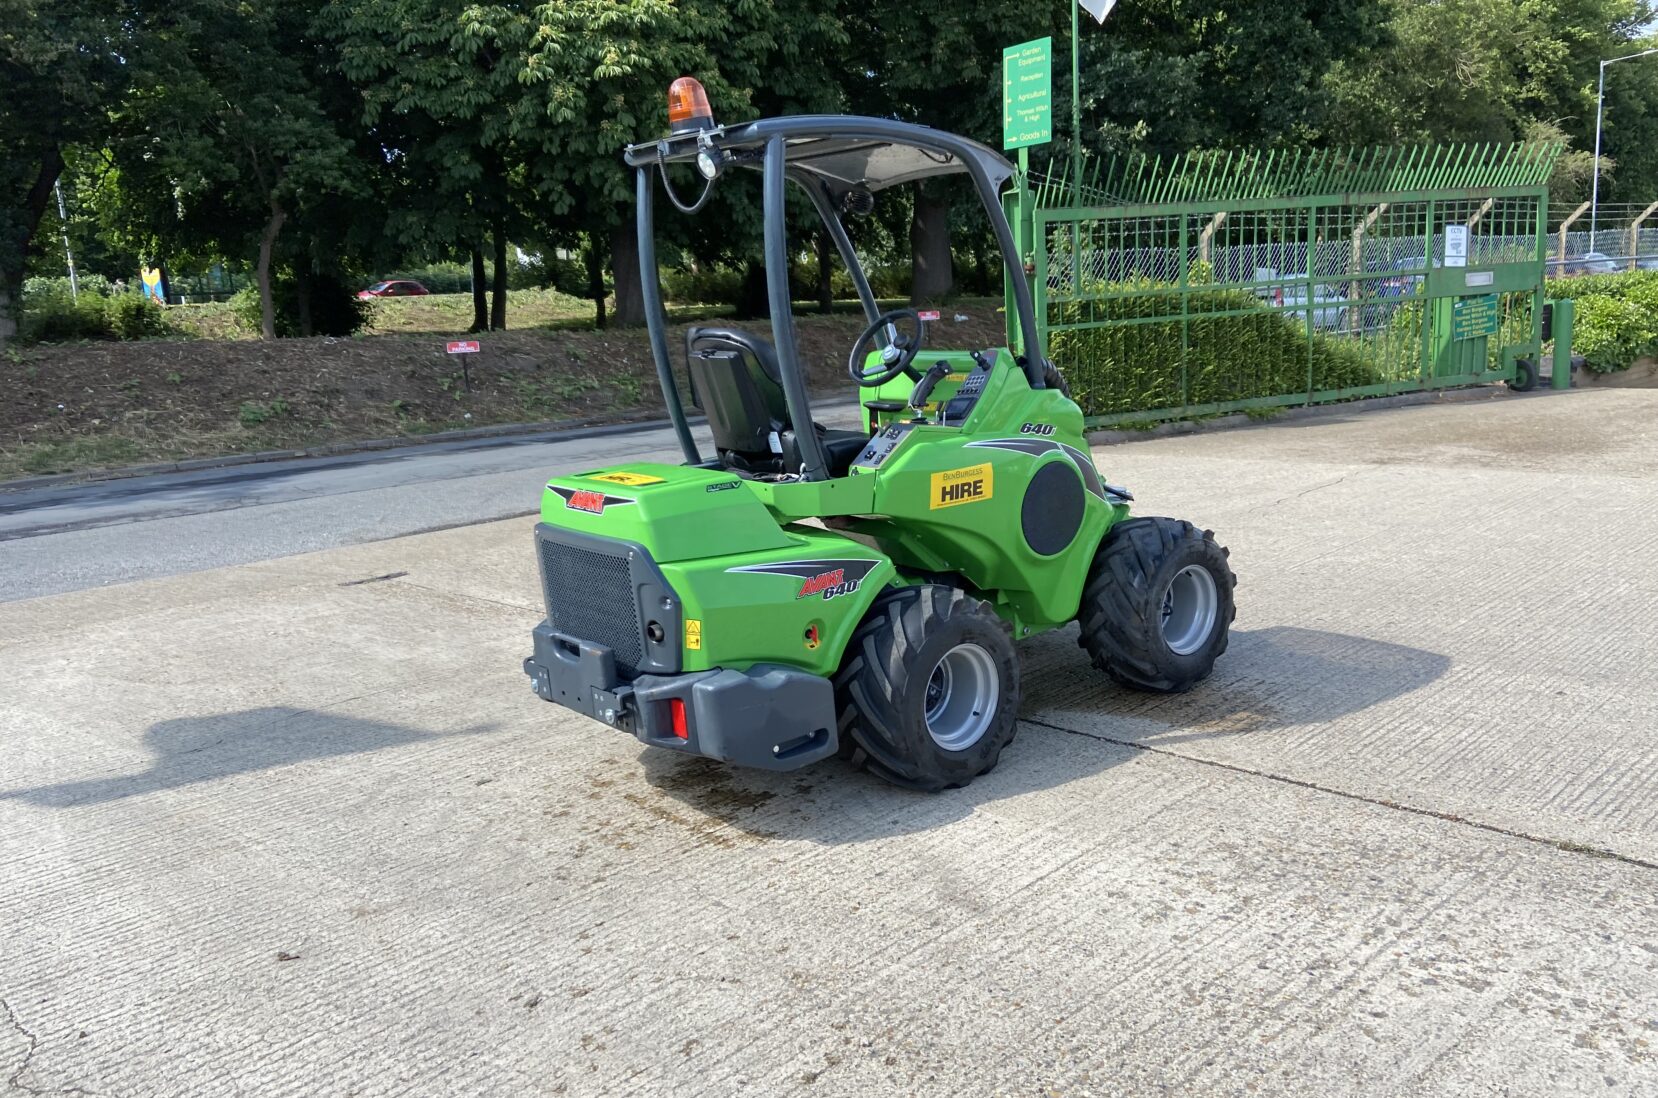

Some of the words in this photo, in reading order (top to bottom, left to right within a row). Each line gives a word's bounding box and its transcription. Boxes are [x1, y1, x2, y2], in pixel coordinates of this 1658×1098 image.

[1022, 47, 1041, 56] Garden
[1018, 54, 1045, 66] Equipment
[1021, 72, 1043, 81] Reception
[1018, 88, 1047, 101] Agricultural
[1019, 131, 1040, 141] Goods
[1041, 129, 1048, 137] In
[1020, 422, 1057, 436] 640i
[941, 479, 984, 502] HIRE
[567, 490, 605, 513] AVANT
[797, 568, 844, 599] AVANT
